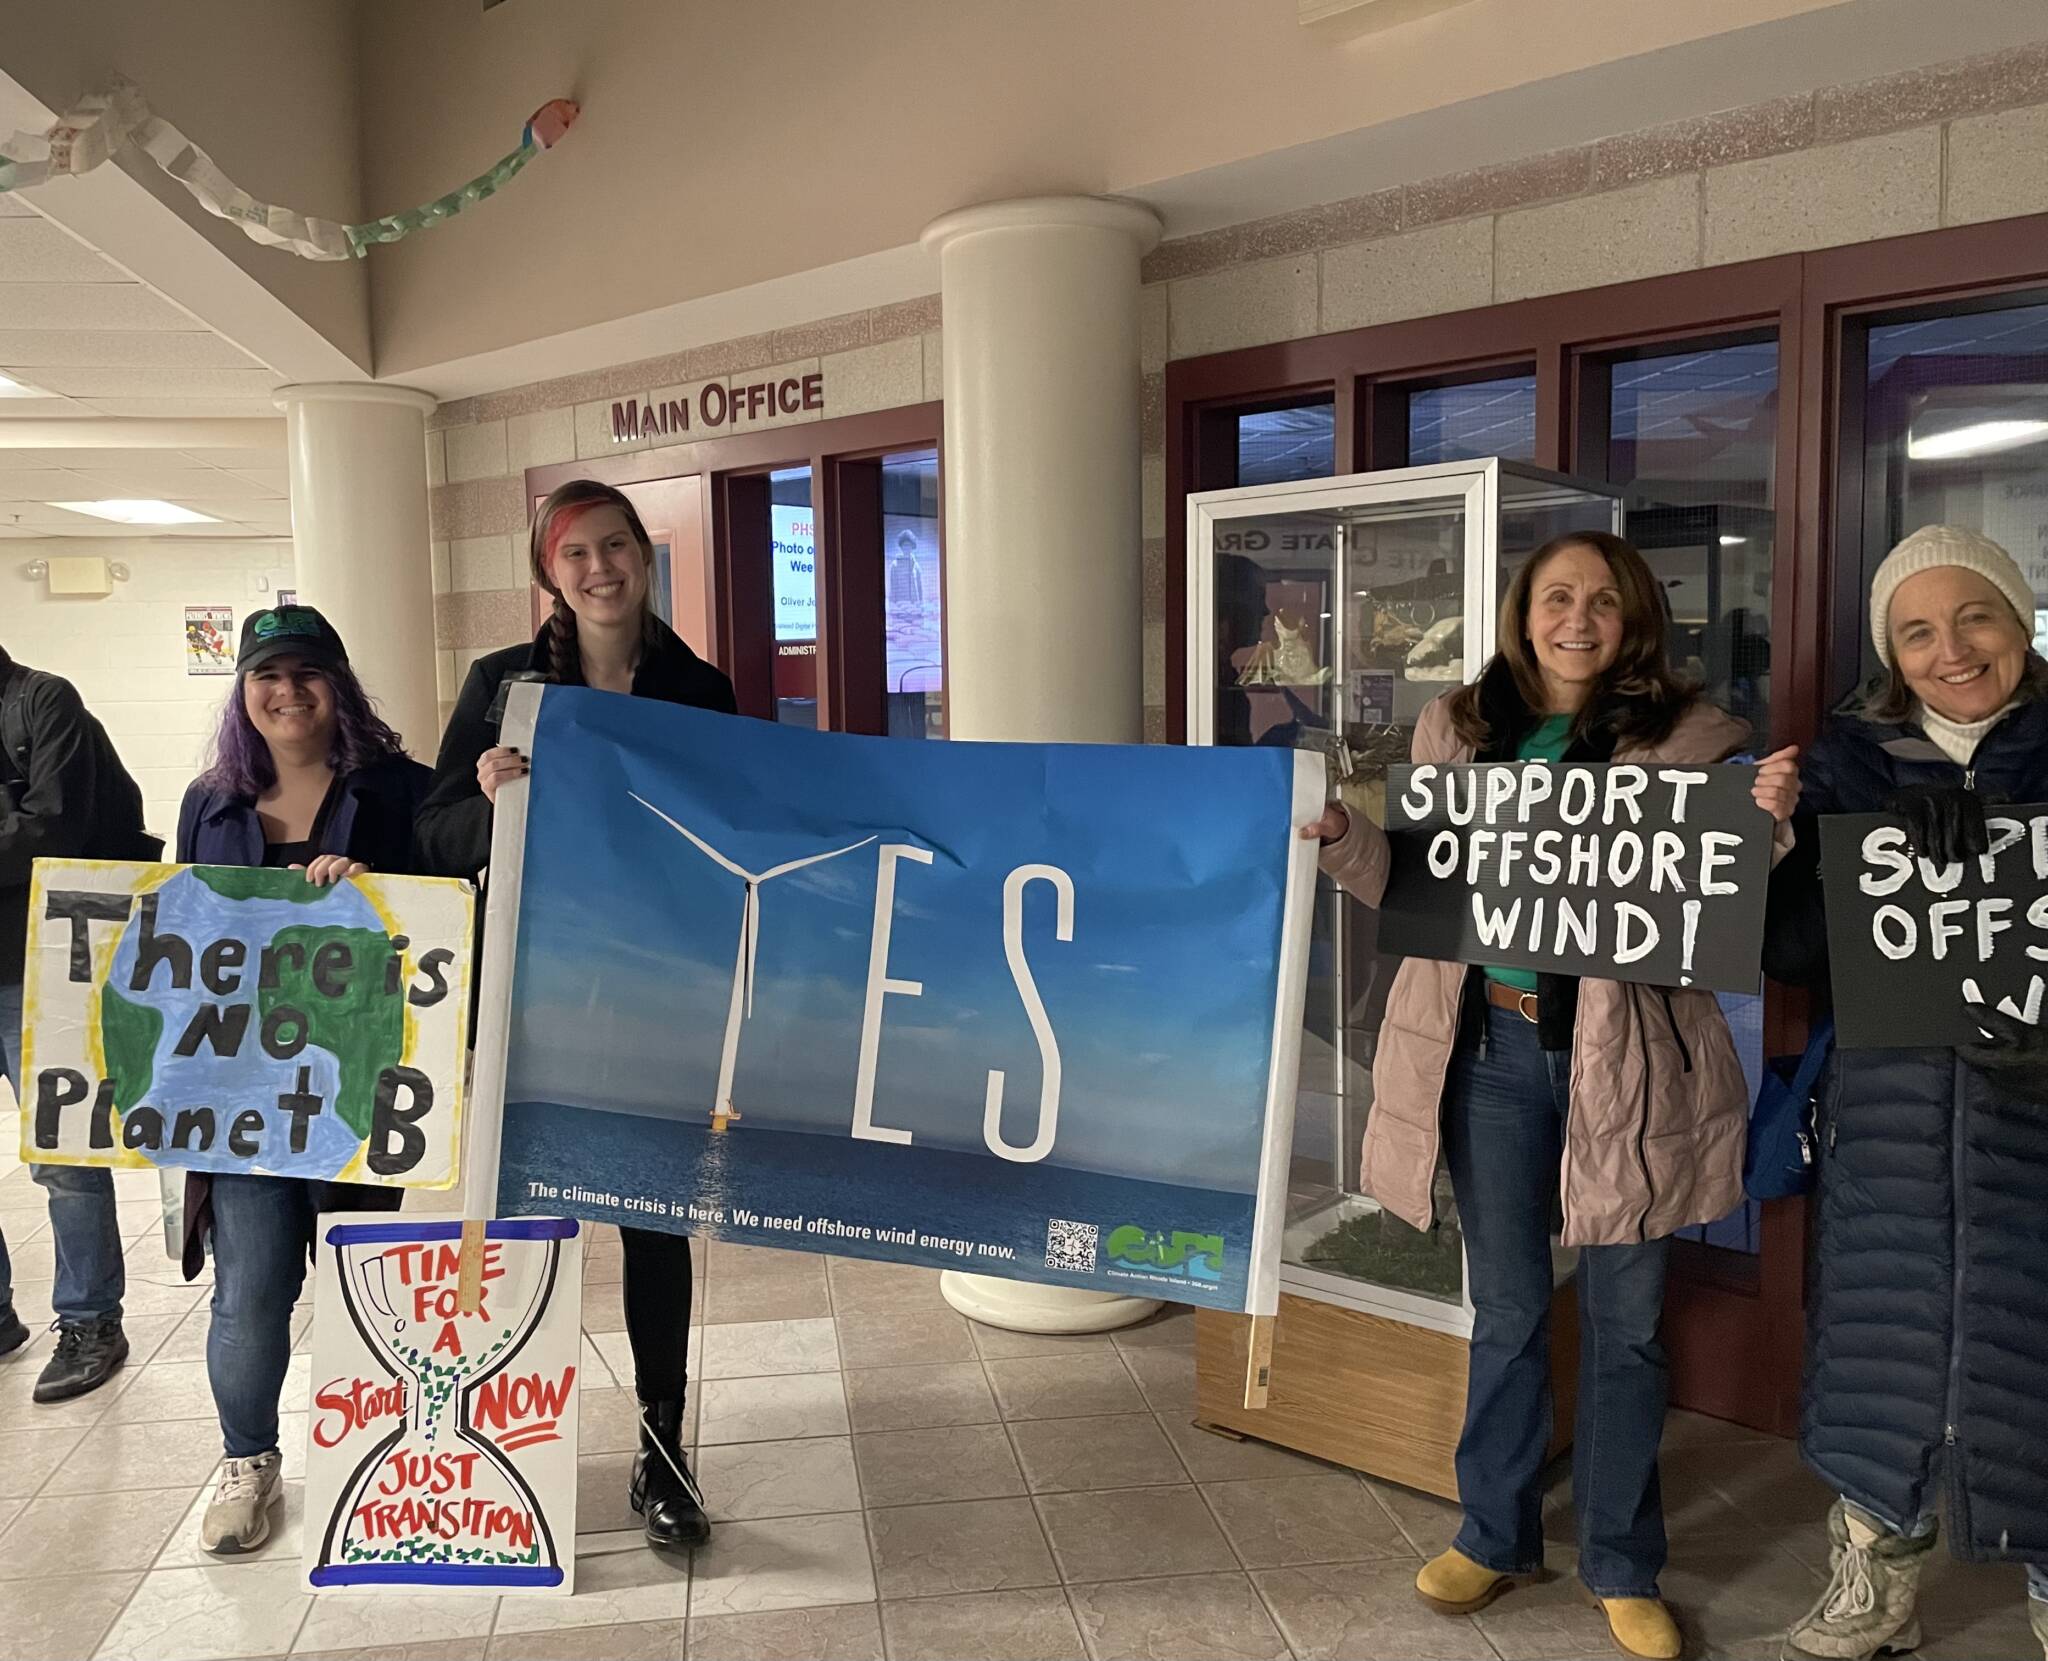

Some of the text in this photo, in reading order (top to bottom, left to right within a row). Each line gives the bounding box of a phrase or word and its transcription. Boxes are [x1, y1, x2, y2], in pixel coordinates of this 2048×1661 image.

[612, 373, 824, 443] MAIN OFFICE
[1401, 764, 1708, 825] SUPPORT
[1427, 829, 1743, 896] OFFSHORE
[45, 889, 455, 1007] There is
[1472, 892, 1701, 986] WIND!
[628, 791, 1076, 1162] YES
[35, 1065, 434, 1176] Planet B
[528, 1182, 1017, 1260] The climate crisis is here. We need offshore wind energy now.
[382, 1243, 505, 1286] TIME
[432, 1320, 462, 1356] A
[313, 1366, 575, 1448] Start NOW
[378, 1447, 481, 1496] JUST
[353, 1496, 533, 1549] TRANSITION
